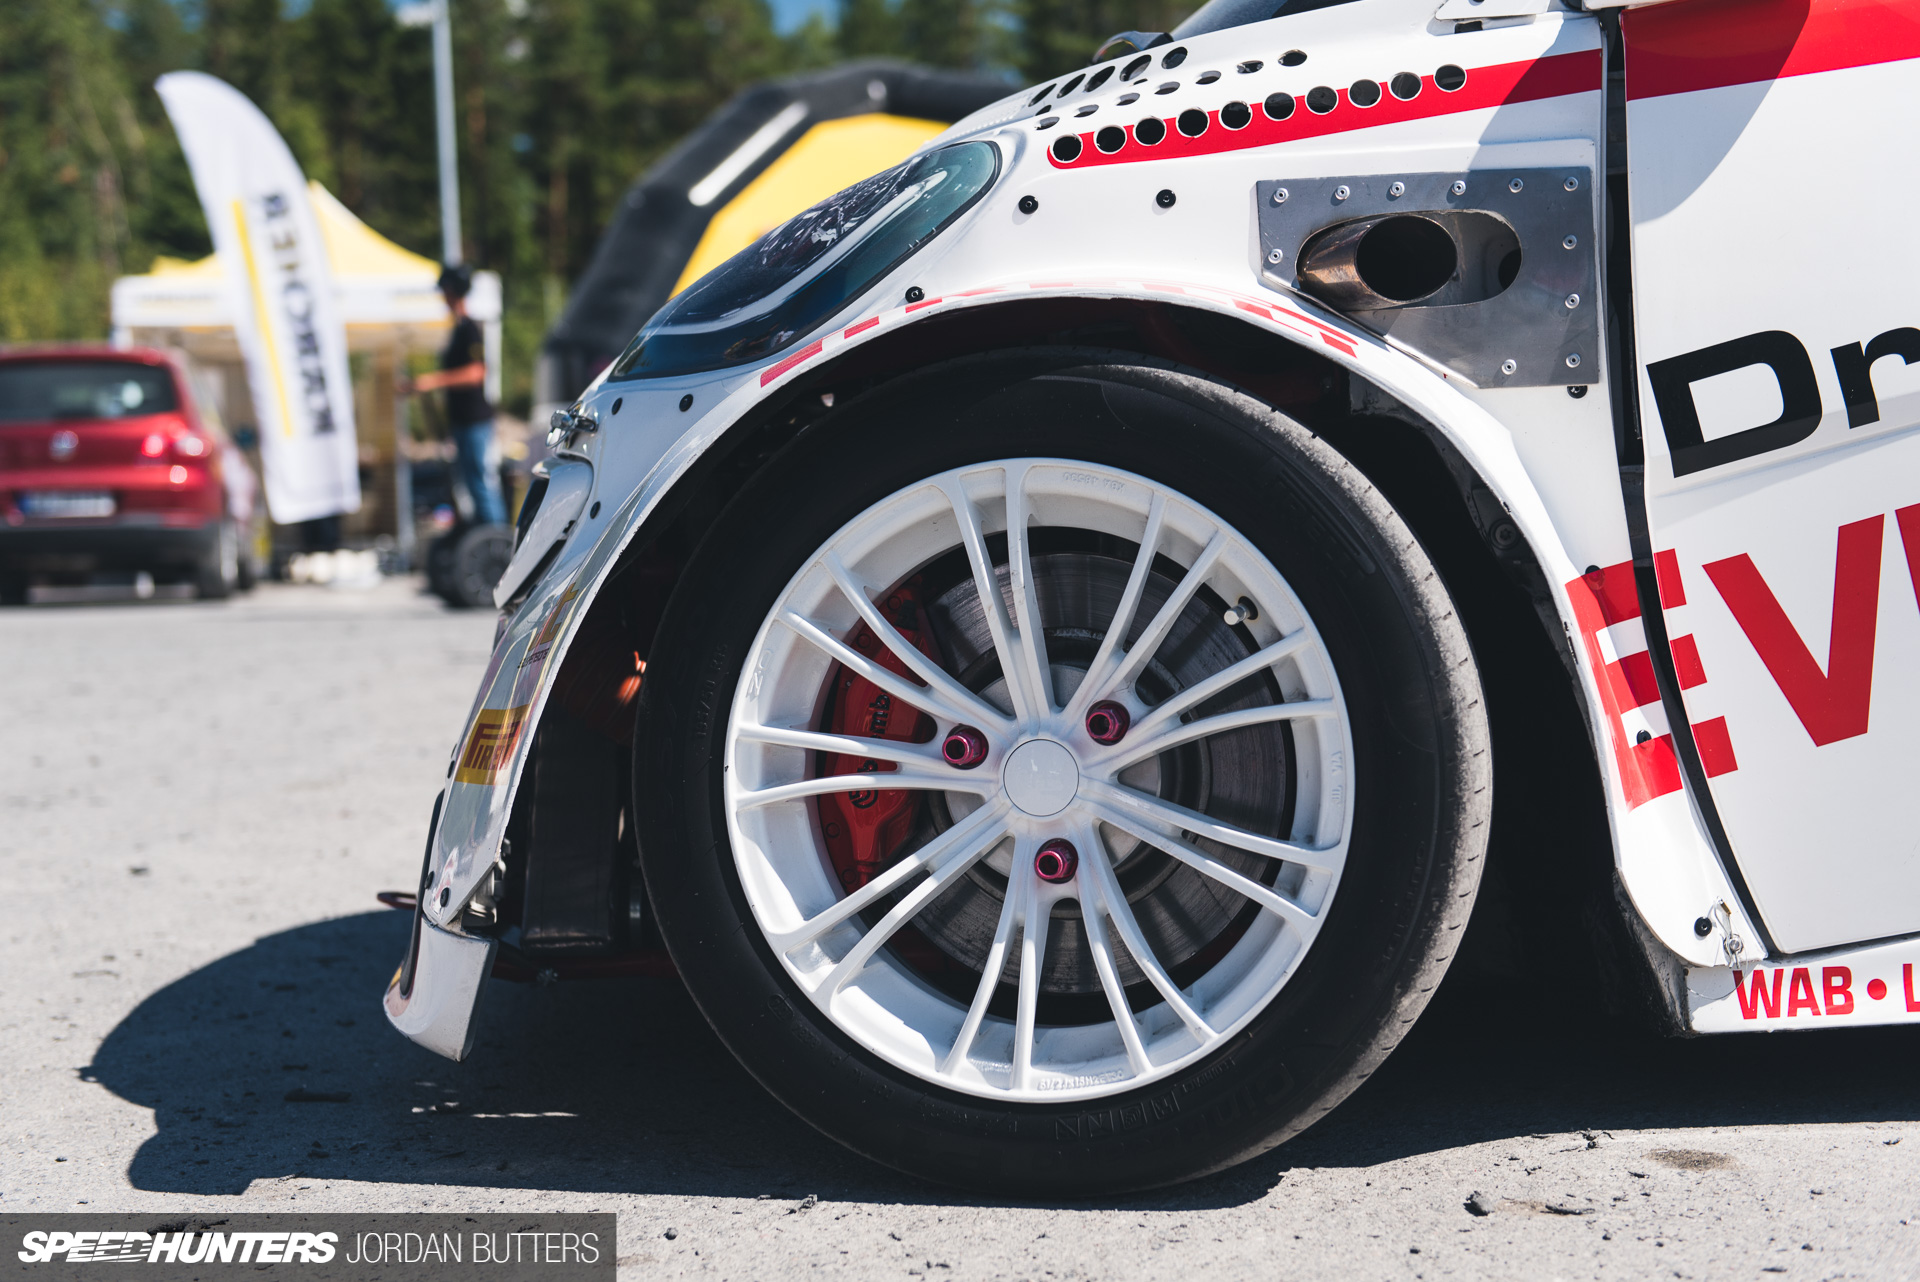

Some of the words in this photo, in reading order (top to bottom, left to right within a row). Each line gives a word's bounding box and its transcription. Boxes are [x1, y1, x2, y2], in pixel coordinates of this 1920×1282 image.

[1565, 503, 1920, 814] EV
[463, 720, 520, 771] PIREL
[1733, 966, 1854, 1020] WAB
